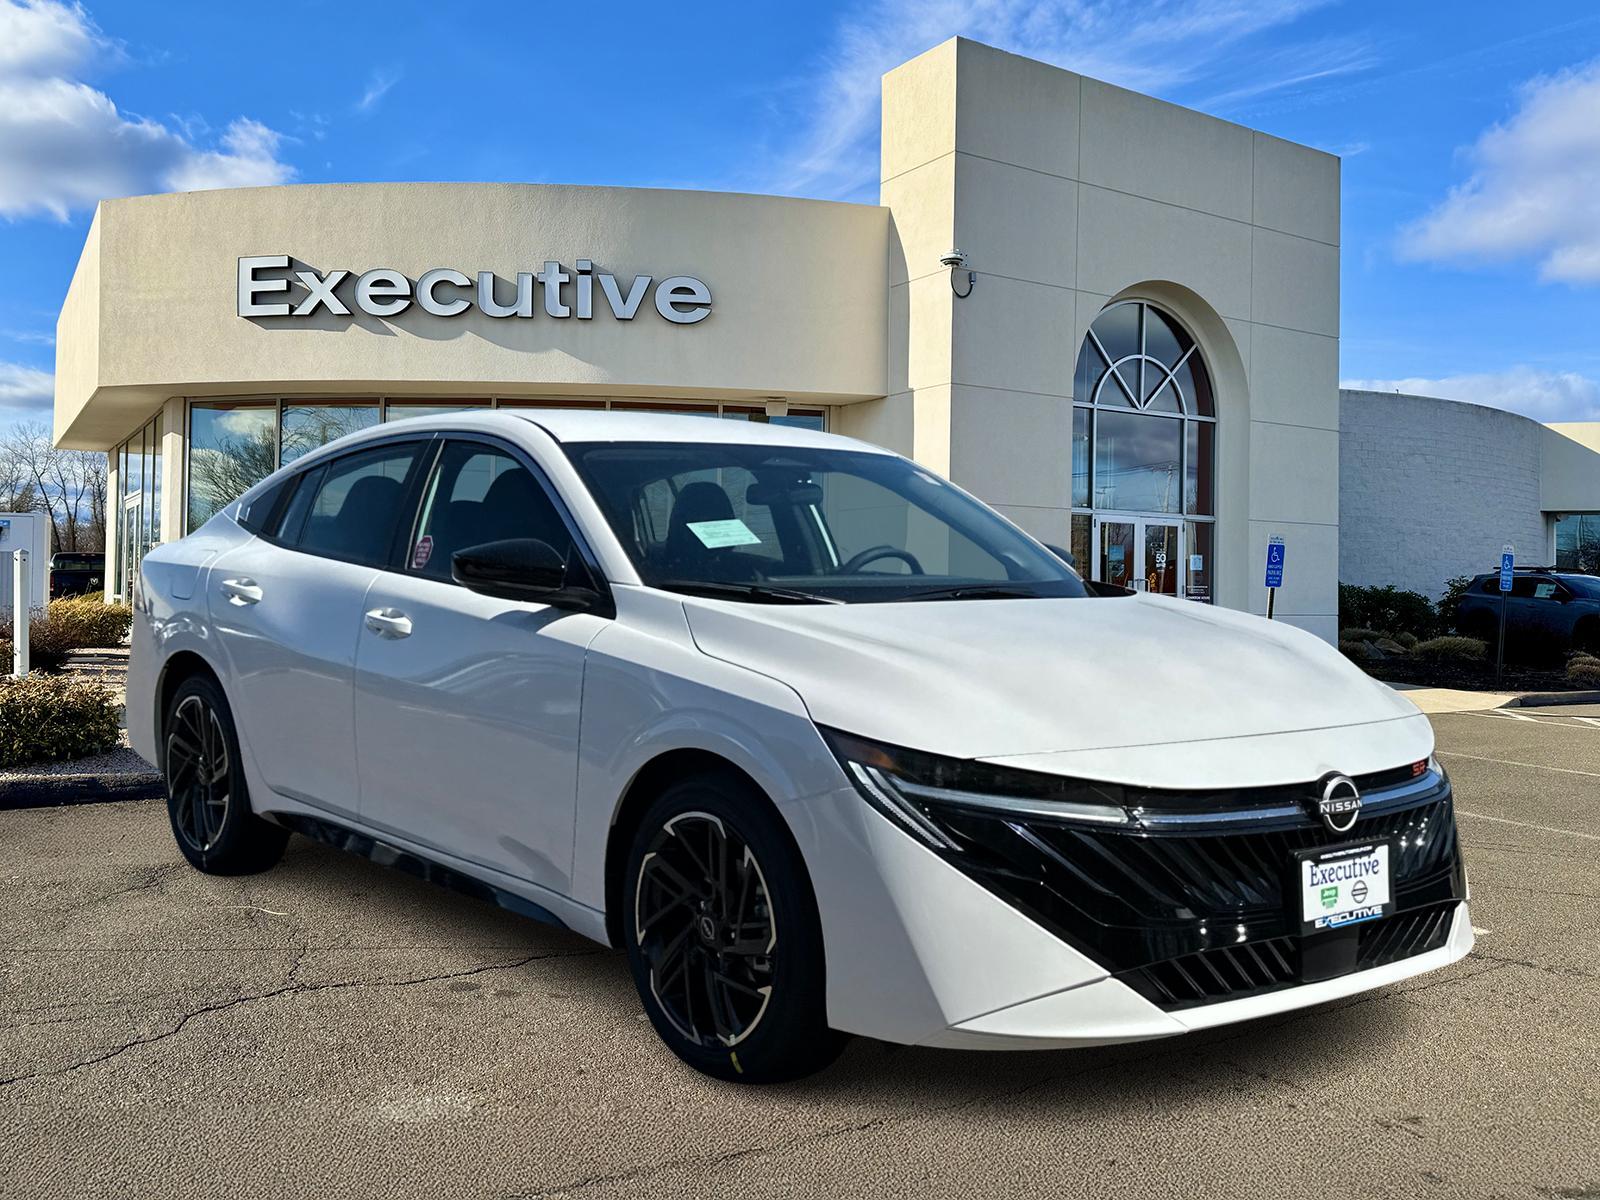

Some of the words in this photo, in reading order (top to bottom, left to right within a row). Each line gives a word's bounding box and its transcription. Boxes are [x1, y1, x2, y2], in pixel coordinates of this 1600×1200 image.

[236, 255, 713, 325] Executive
[1412, 761, 1426, 776] SR
[1320, 800, 1362, 813] NISSAN
[1310, 857, 1379, 887] Executive
[1315, 905, 1382, 928] EXECUTIVE
